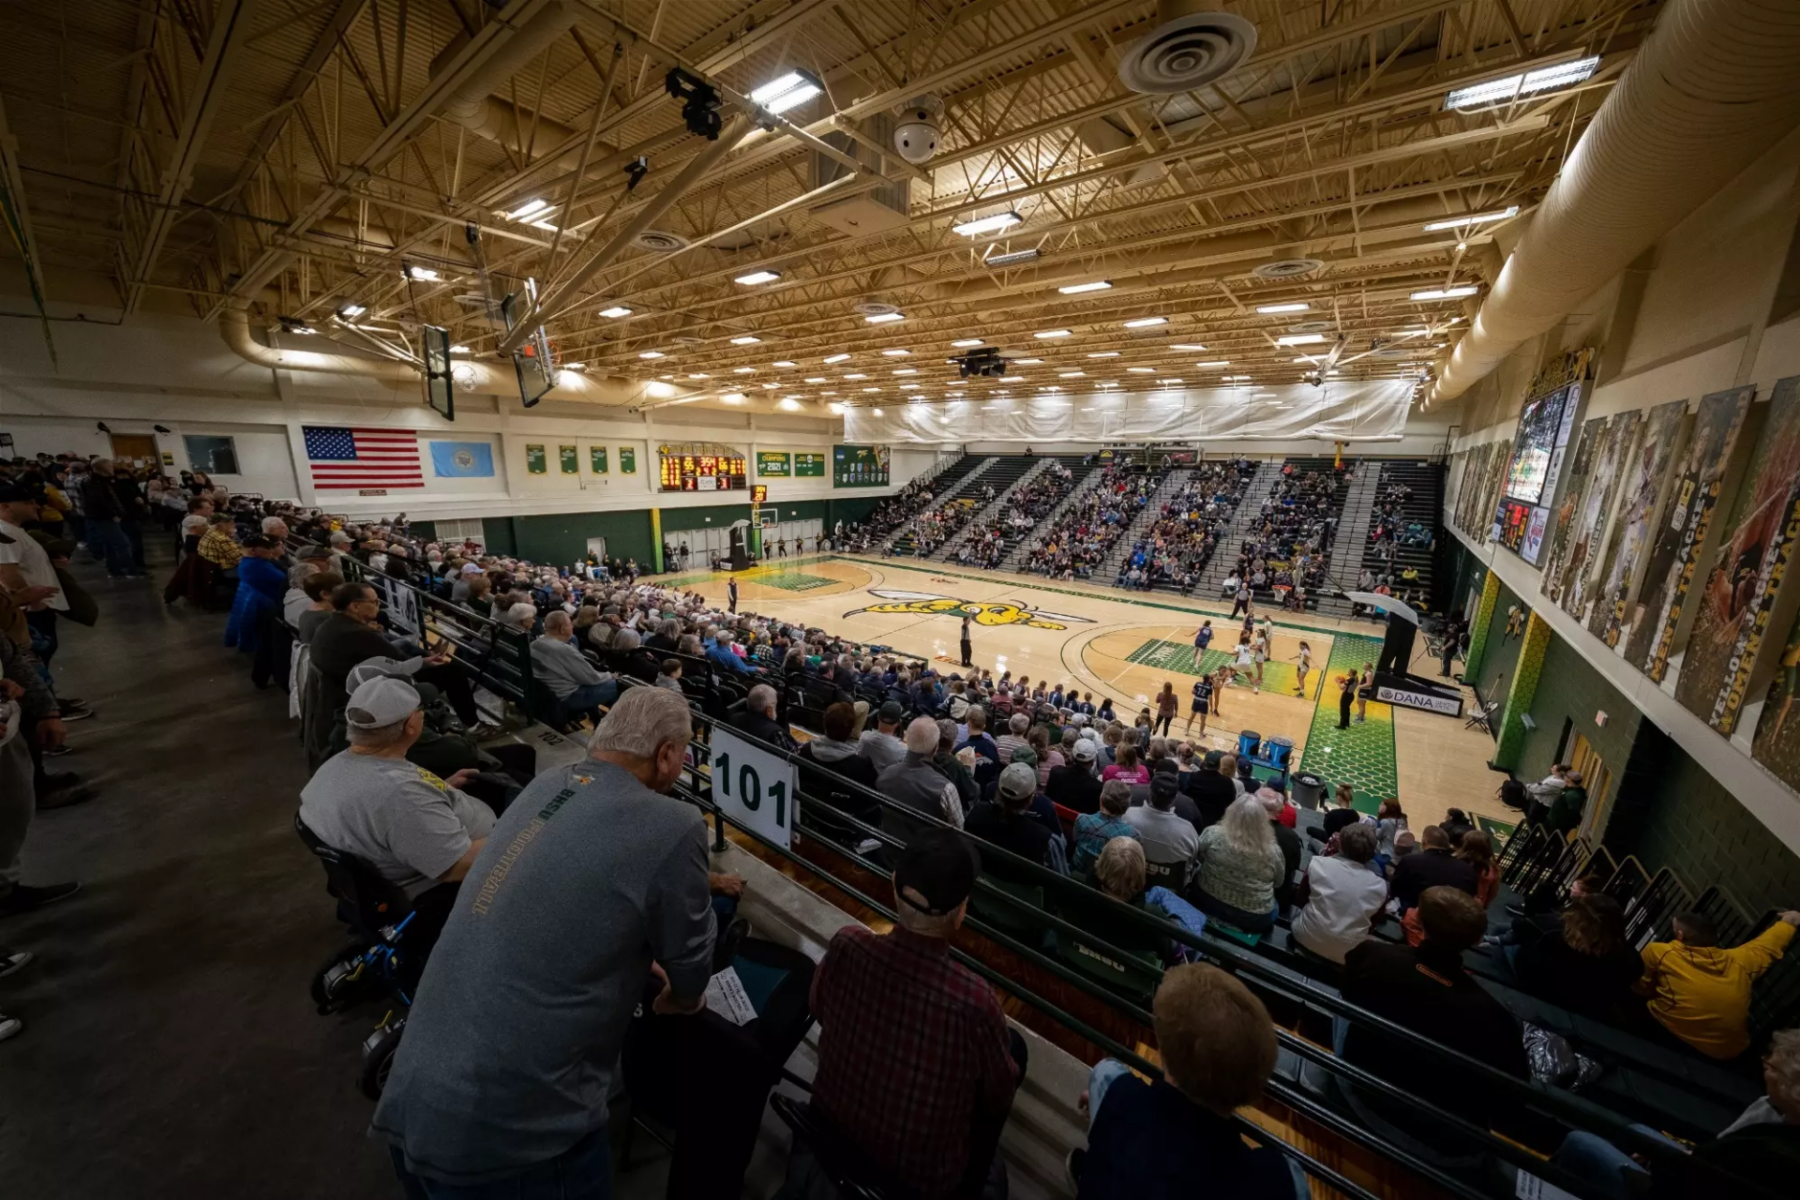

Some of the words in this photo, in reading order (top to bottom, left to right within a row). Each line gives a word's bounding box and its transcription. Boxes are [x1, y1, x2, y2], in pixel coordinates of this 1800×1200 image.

[767, 463, 781, 471] 2021
[1676, 482, 1710, 574] JACKET
[1650, 604, 1681, 681] MEN'S
[1678, 506, 1714, 594] TRACK
[1708, 632, 1748, 726] YELLOW
[1746, 530, 1784, 627] JACKET
[1720, 609, 1770, 733] WOMEN'S
[1764, 499, 1800, 599] TRACK
[538, 732, 564, 745] 102
[1394, 692, 1433, 708] DANA
[538, 788, 576, 820] BHSU
[716, 752, 785, 828] 101
[472, 818, 545, 915] FOOTBALL
